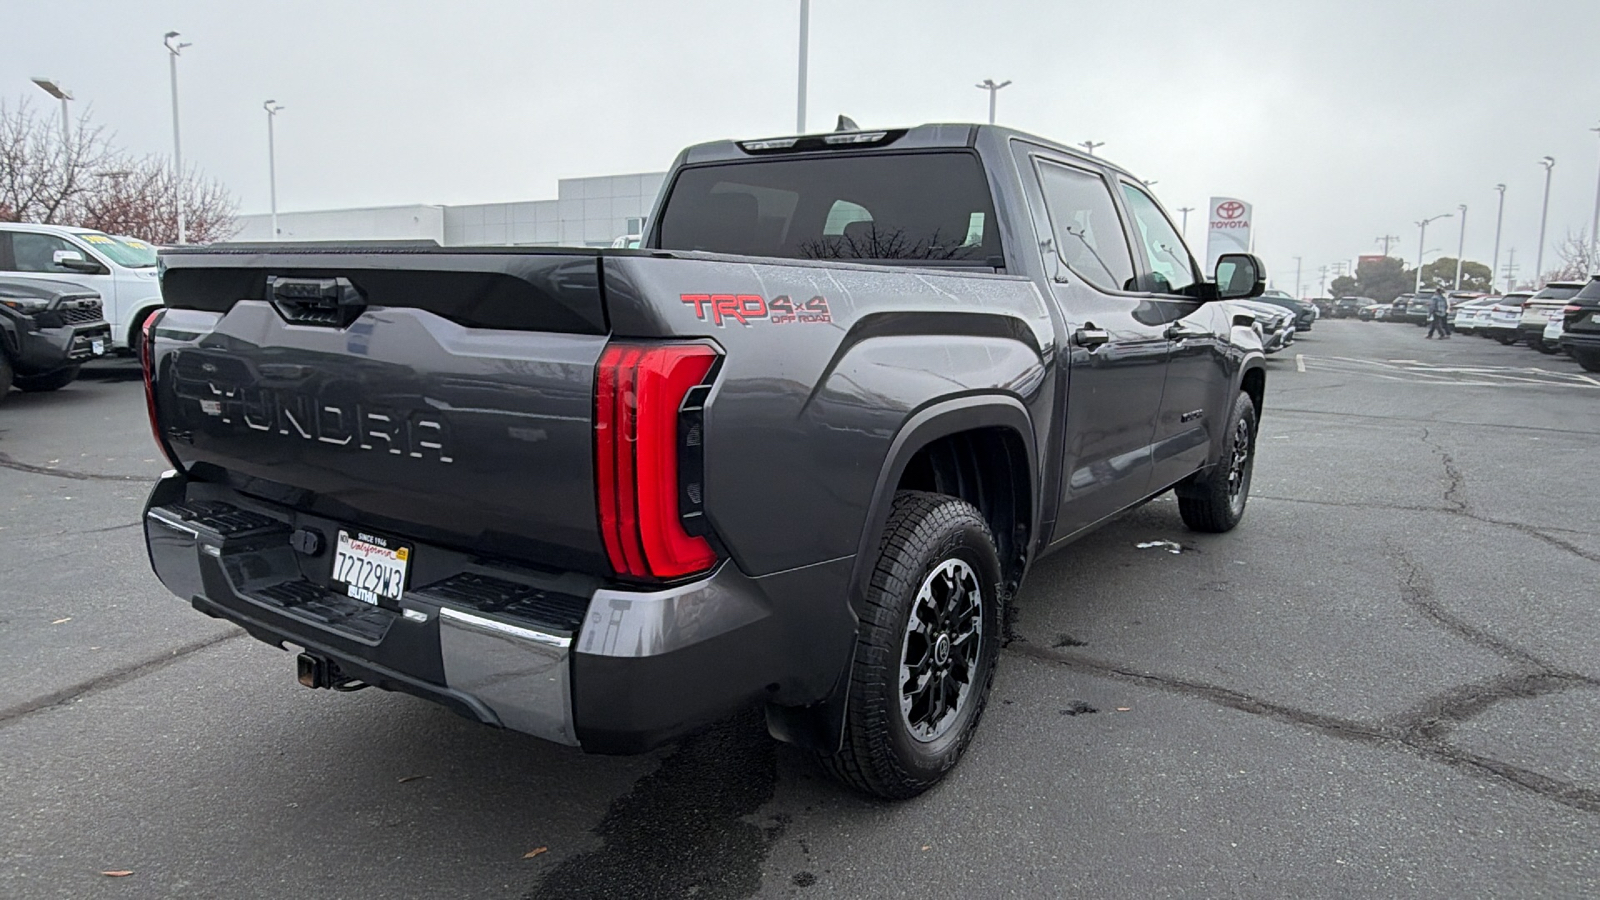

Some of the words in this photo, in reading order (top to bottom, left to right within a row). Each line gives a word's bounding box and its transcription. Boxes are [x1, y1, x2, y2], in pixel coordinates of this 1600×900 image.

[680, 294, 769, 327] TRD
[768, 295, 830, 315] 4x4
[771, 315, 796, 324] OFF
[798, 315, 832, 324] ROAD
[206, 381, 454, 463] TUNDRA
[358, 532, 374, 544] SINCE
[374, 536, 388, 547] 1946
[351, 540, 397, 560] California
[338, 552, 402, 599] 72729W3
[353, 586, 379, 605] LITHIA
